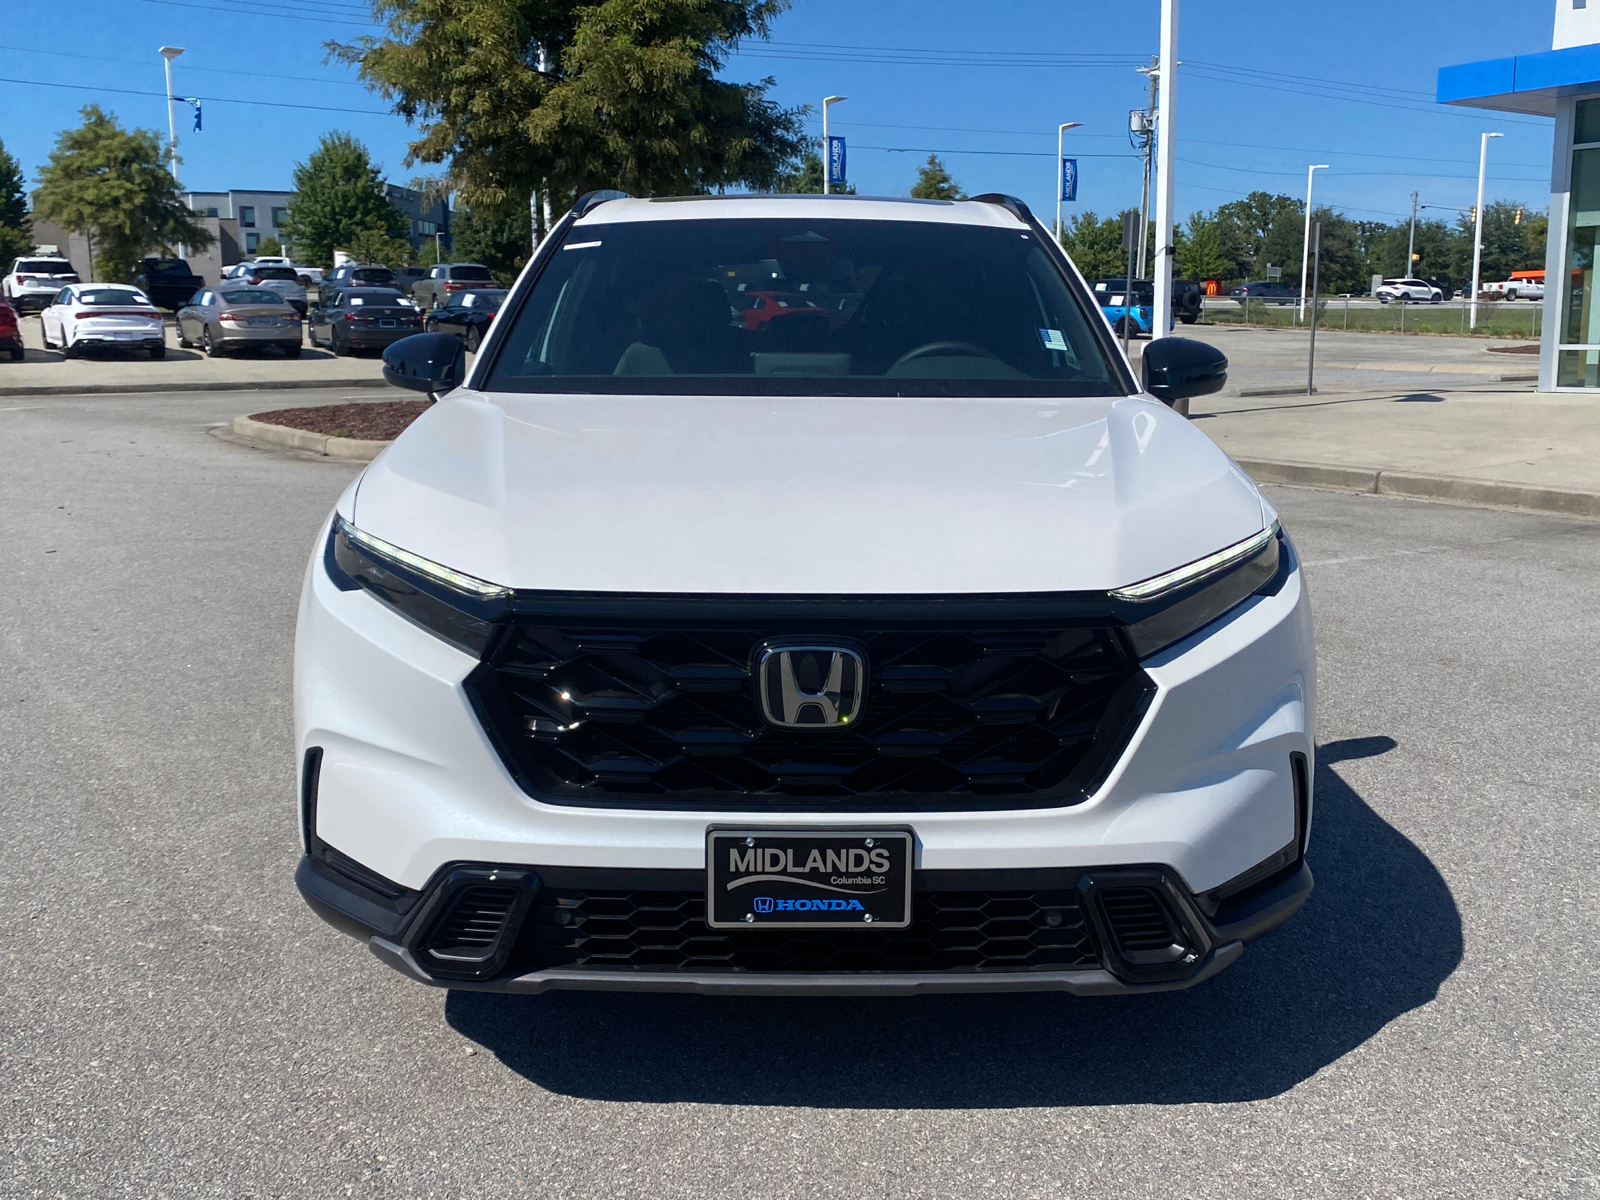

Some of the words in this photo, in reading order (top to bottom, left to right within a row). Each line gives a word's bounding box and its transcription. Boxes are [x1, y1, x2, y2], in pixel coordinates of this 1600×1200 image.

[729, 848, 890, 873] MIDLANDS
[830, 875, 872, 885] Columbia
[872, 875, 886, 885] SC
[776, 899, 865, 911] HONDA
